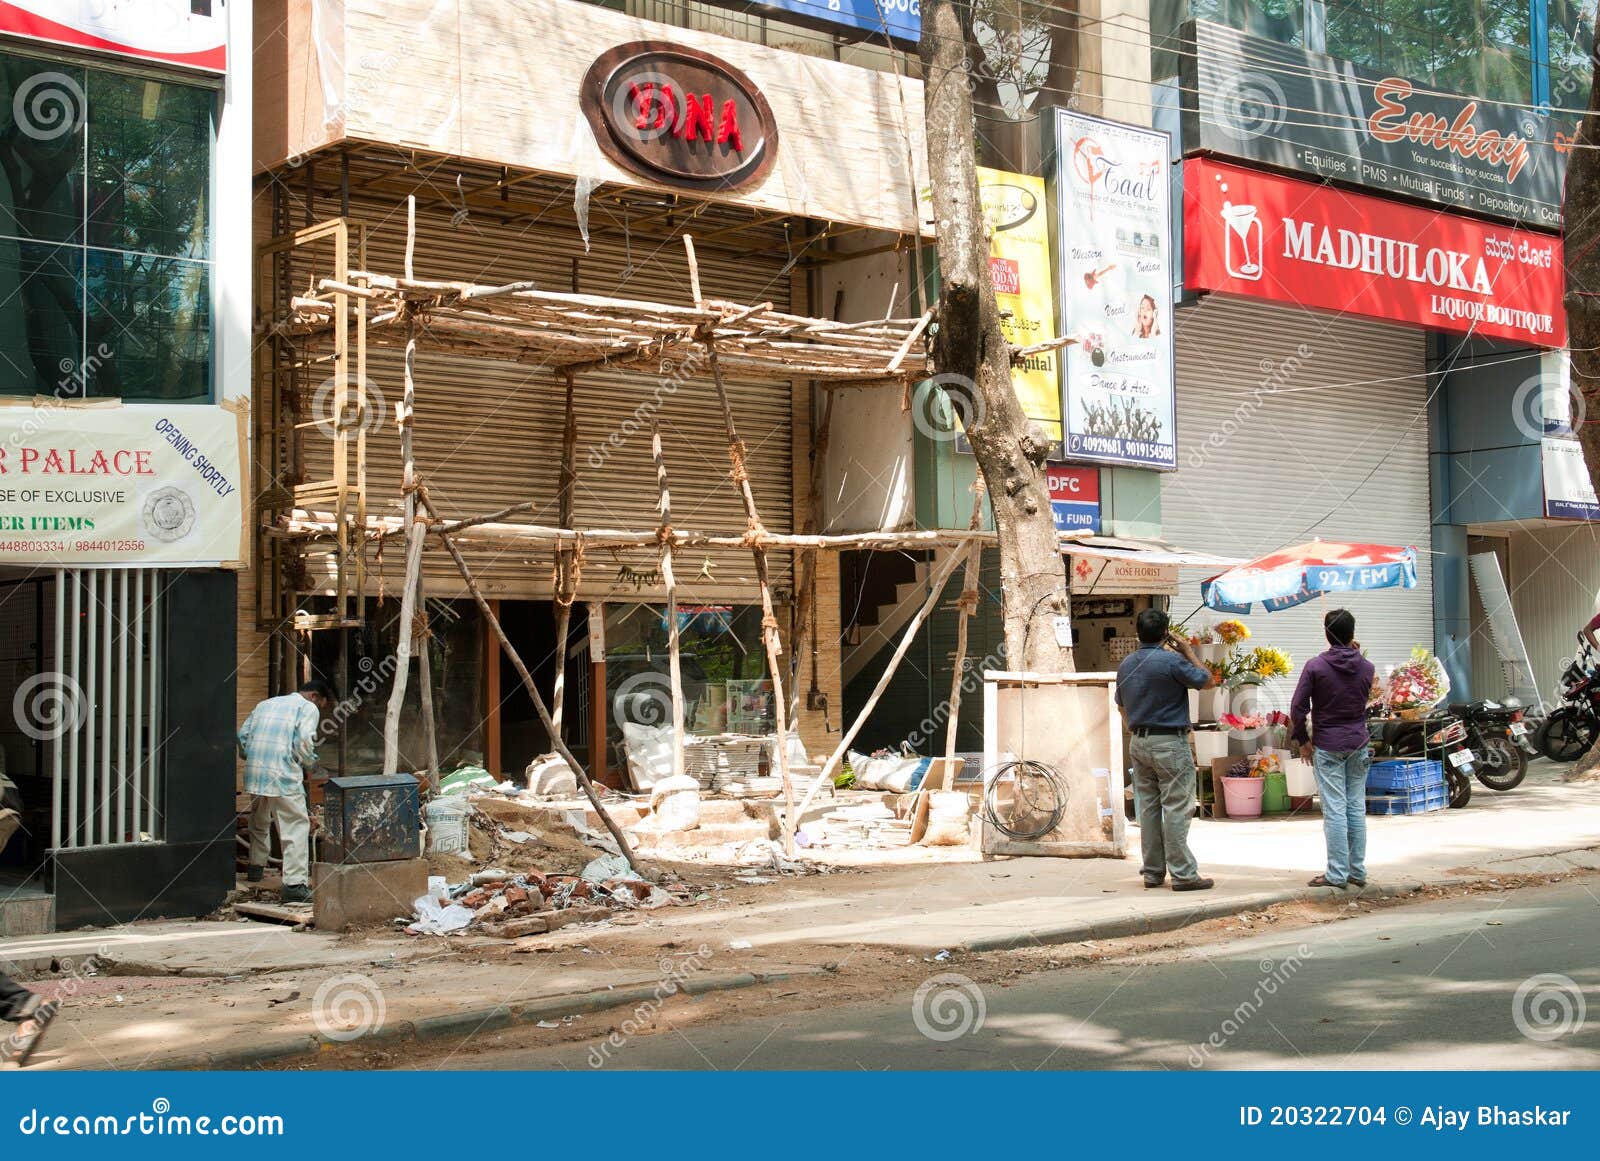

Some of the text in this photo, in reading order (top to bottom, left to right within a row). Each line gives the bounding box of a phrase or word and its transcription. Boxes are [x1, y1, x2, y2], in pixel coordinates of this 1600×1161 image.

[1368, 77, 1530, 184] Emkay
[1411, 151, 1428, 165] Your
[1430, 158, 1457, 172] success
[1465, 167, 1478, 177] our
[1479, 169, 1504, 183] success
[1096, 156, 1157, 200] Taal
[1304, 151, 1347, 173] Equities
[1363, 164, 1388, 183] PMS
[1400, 173, 1433, 193] Mutual
[1435, 181, 1465, 201] Funds
[1479, 193, 1528, 217] Depository
[1071, 247, 1103, 260] Western
[1282, 217, 1494, 296] MADHULOKA
[1136, 260, 1161, 273] Indian
[1104, 303, 1126, 317] Vocal
[1430, 294, 1554, 334] LIQUOR BOUTIQUE
[1110, 350, 1157, 363] Instrumental
[1091, 374, 1118, 391] Dance
[1130, 380, 1150, 395] Arts
[155, 418, 236, 498] OPENING SHORTLY
[1126, 440, 1174, 460] 9019154508
[20, 448, 155, 476] PALACE
[21, 490, 40, 503] OF
[45, 490, 125, 504] EXCLUSIVE
[31, 516, 96, 531] ITEMS
[1066, 513, 1093, 525] FUND
[0, 539, 64, 552] 448803334
[75, 539, 145, 552] 9844012556
[1115, 567, 1161, 577] ROSE FLORIST
[1318, 567, 1389, 586] 92.7 FM
